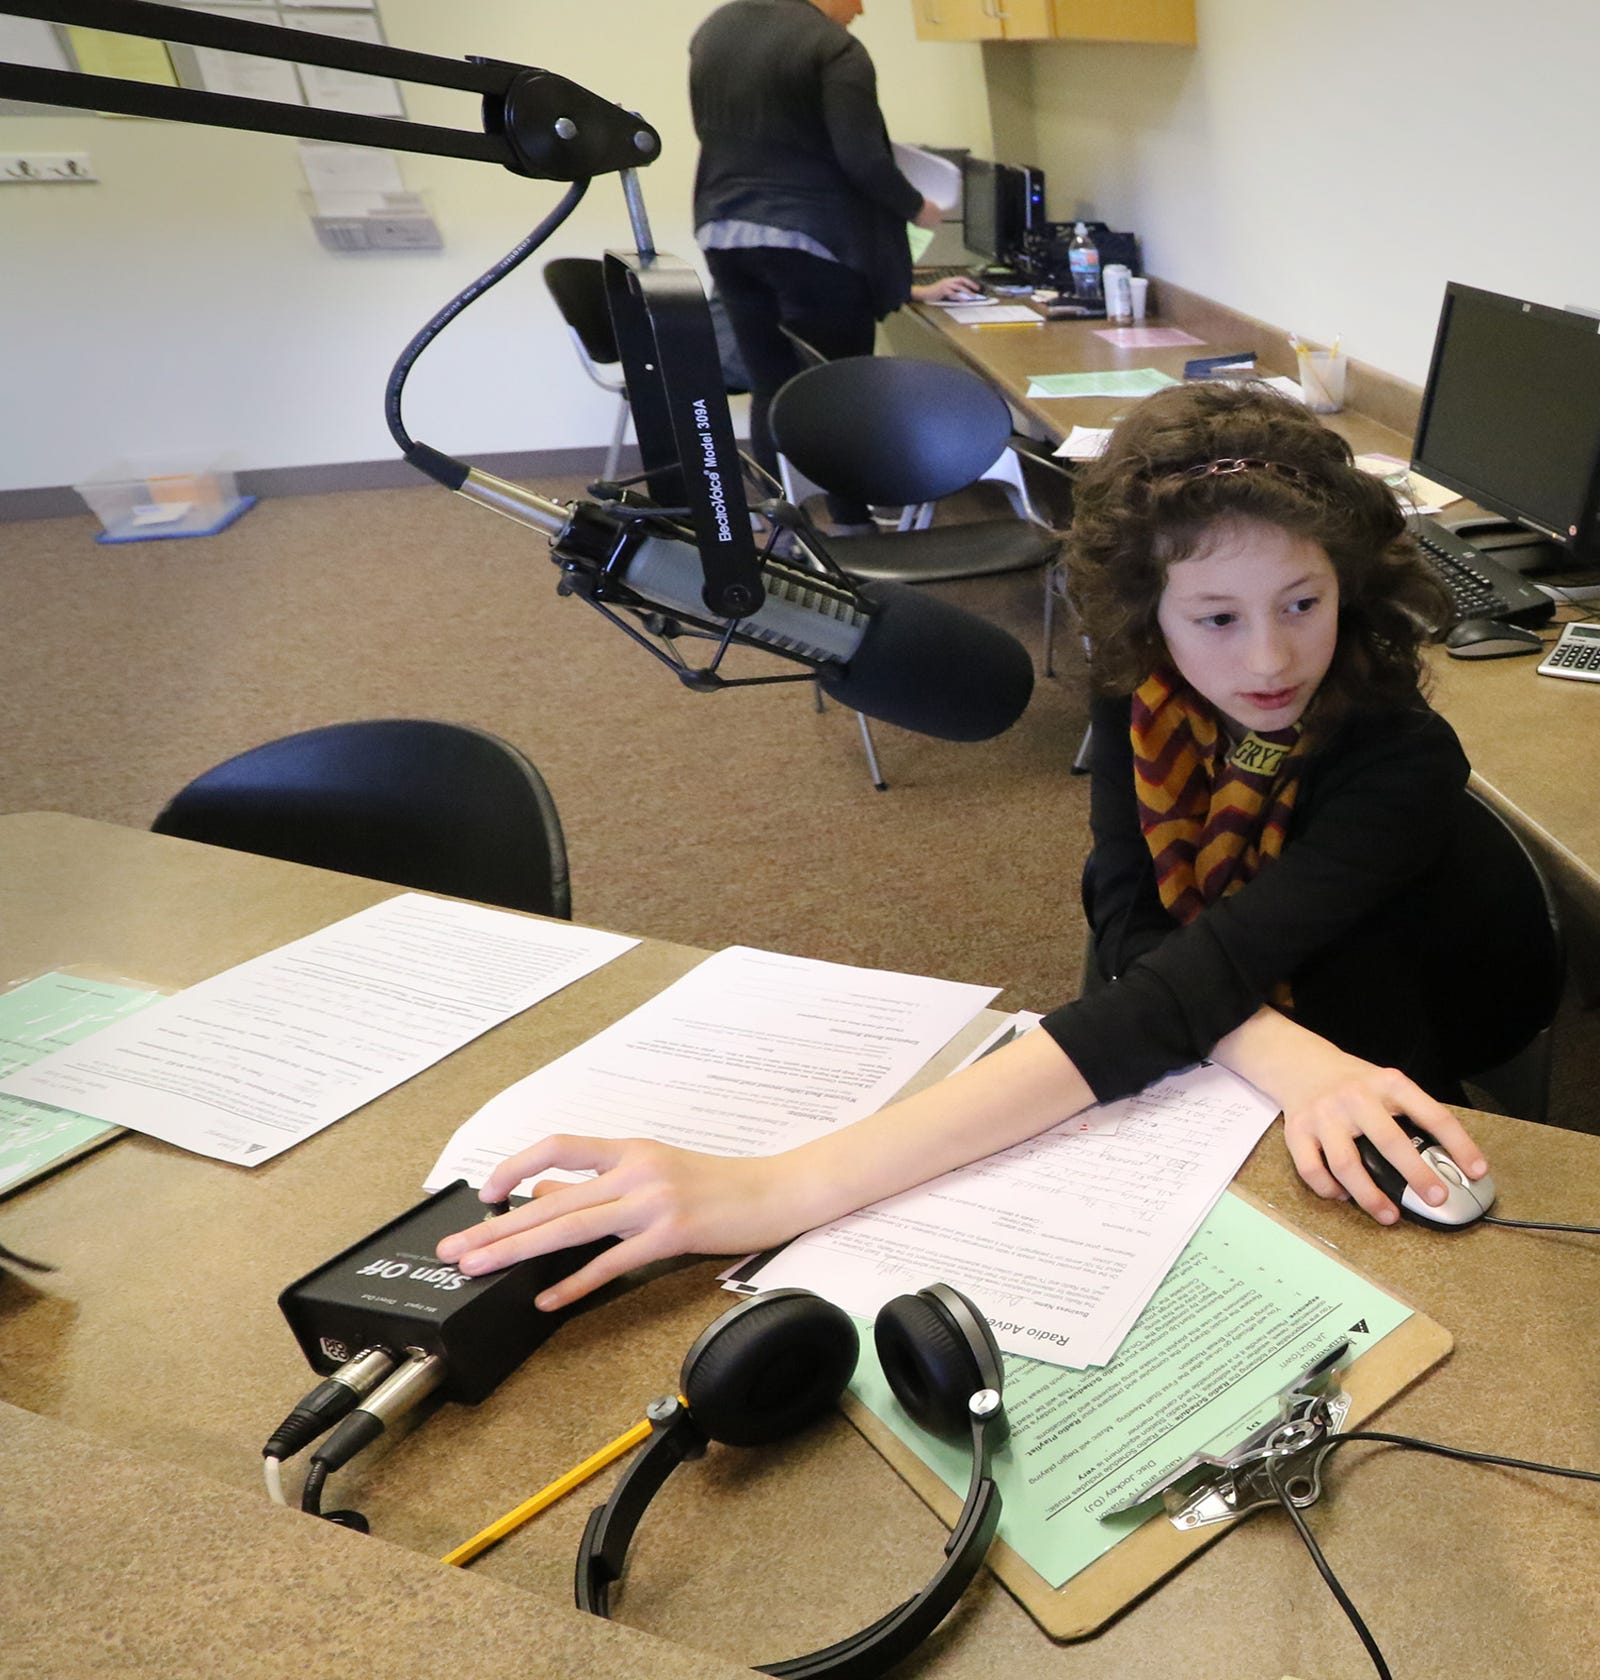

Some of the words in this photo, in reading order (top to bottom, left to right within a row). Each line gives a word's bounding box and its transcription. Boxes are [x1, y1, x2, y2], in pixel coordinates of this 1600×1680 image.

[693, 399, 710, 429] 309A
[699, 432, 717, 467] Model
[356, 1259, 408, 1279] Off
[409, 1267, 471, 1290] Sign
[1054, 1305, 1090, 1317] Business
[1023, 1327, 1071, 1346] Radio
[1133, 1458, 1157, 1476] Disc
[1103, 1472, 1137, 1498] Jockey
[1082, 1495, 1107, 1514] (DJ)
